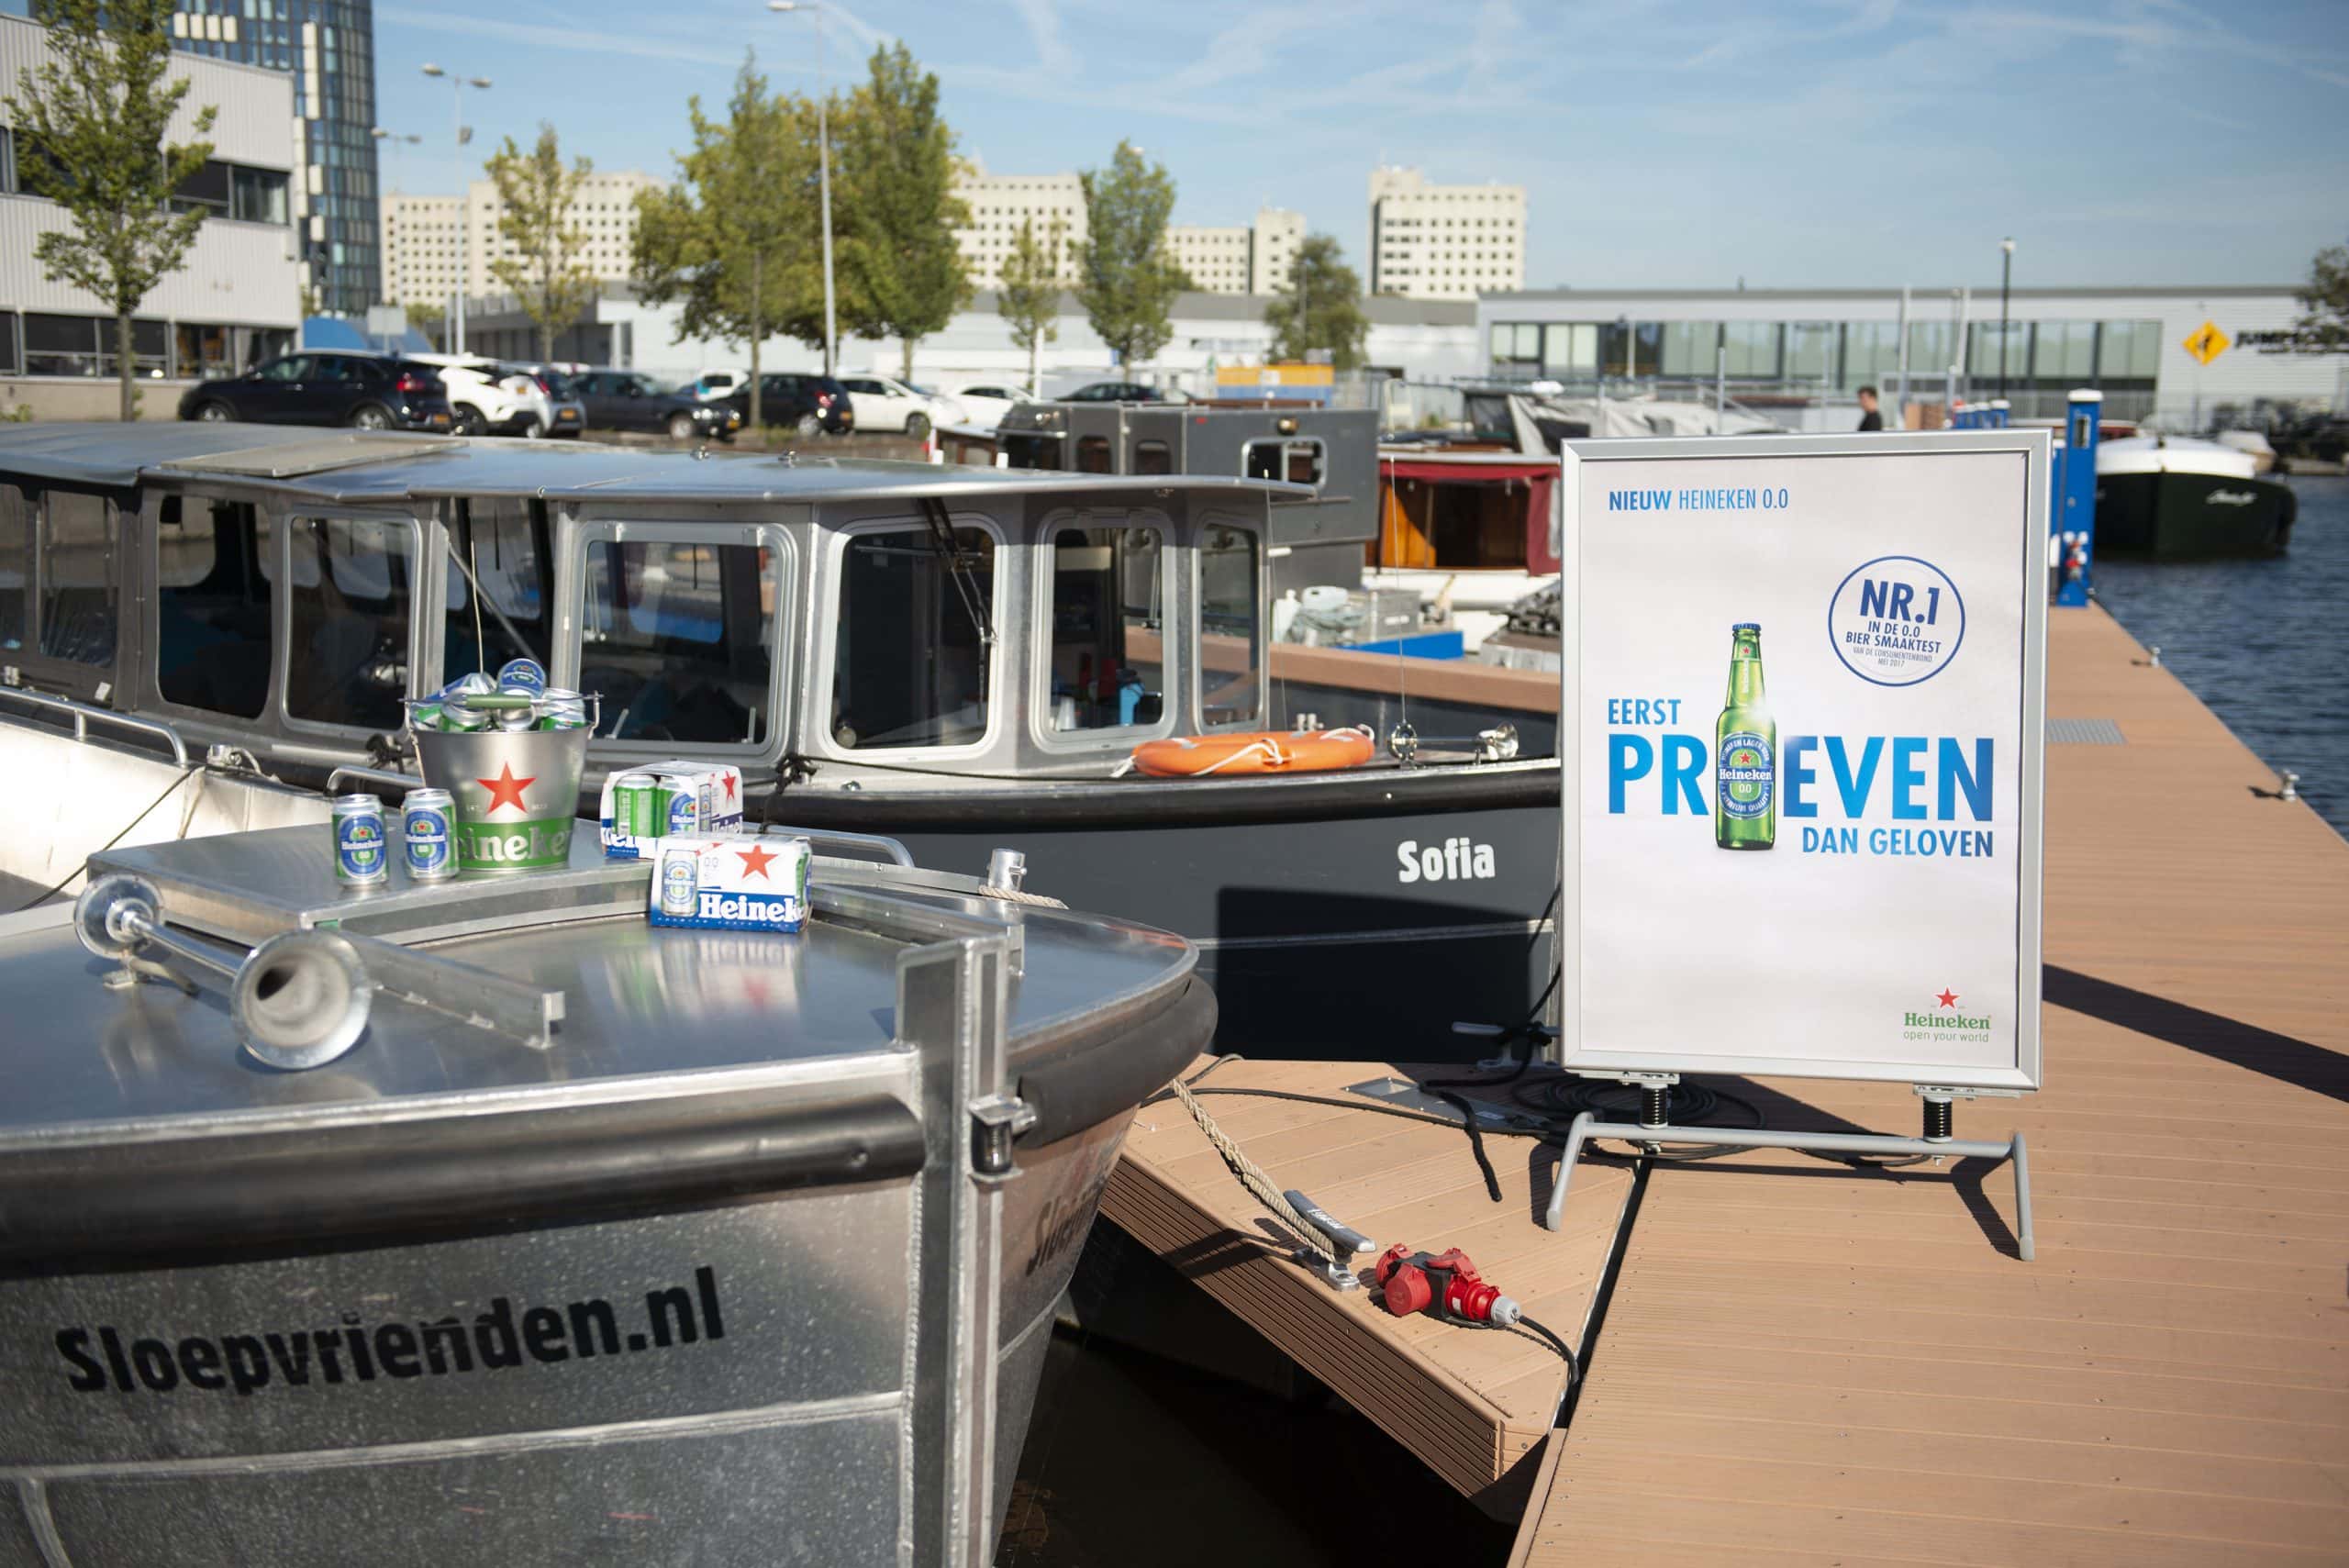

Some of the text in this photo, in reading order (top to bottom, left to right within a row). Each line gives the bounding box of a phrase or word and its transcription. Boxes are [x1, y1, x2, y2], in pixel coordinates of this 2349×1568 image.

[1609, 488, 1788, 511] NIEUW HEINEKEN 0.0
[1860, 579, 1941, 626] NR.1
[1868, 620, 1920, 638] IN DE 0.0
[1845, 631, 1942, 653] BIER SMAAKTEST
[1609, 698, 1682, 725] EERST
[1719, 768, 1773, 781] Heineken
[1803, 827, 1994, 858] DAN GELOVEN
[1397, 837, 1496, 884] Sofia
[1904, 1012, 1990, 1030] Heineken
[1903, 1030, 1989, 1043] open your world
[55, 1265, 725, 1396] Sloepvrienden.nl
